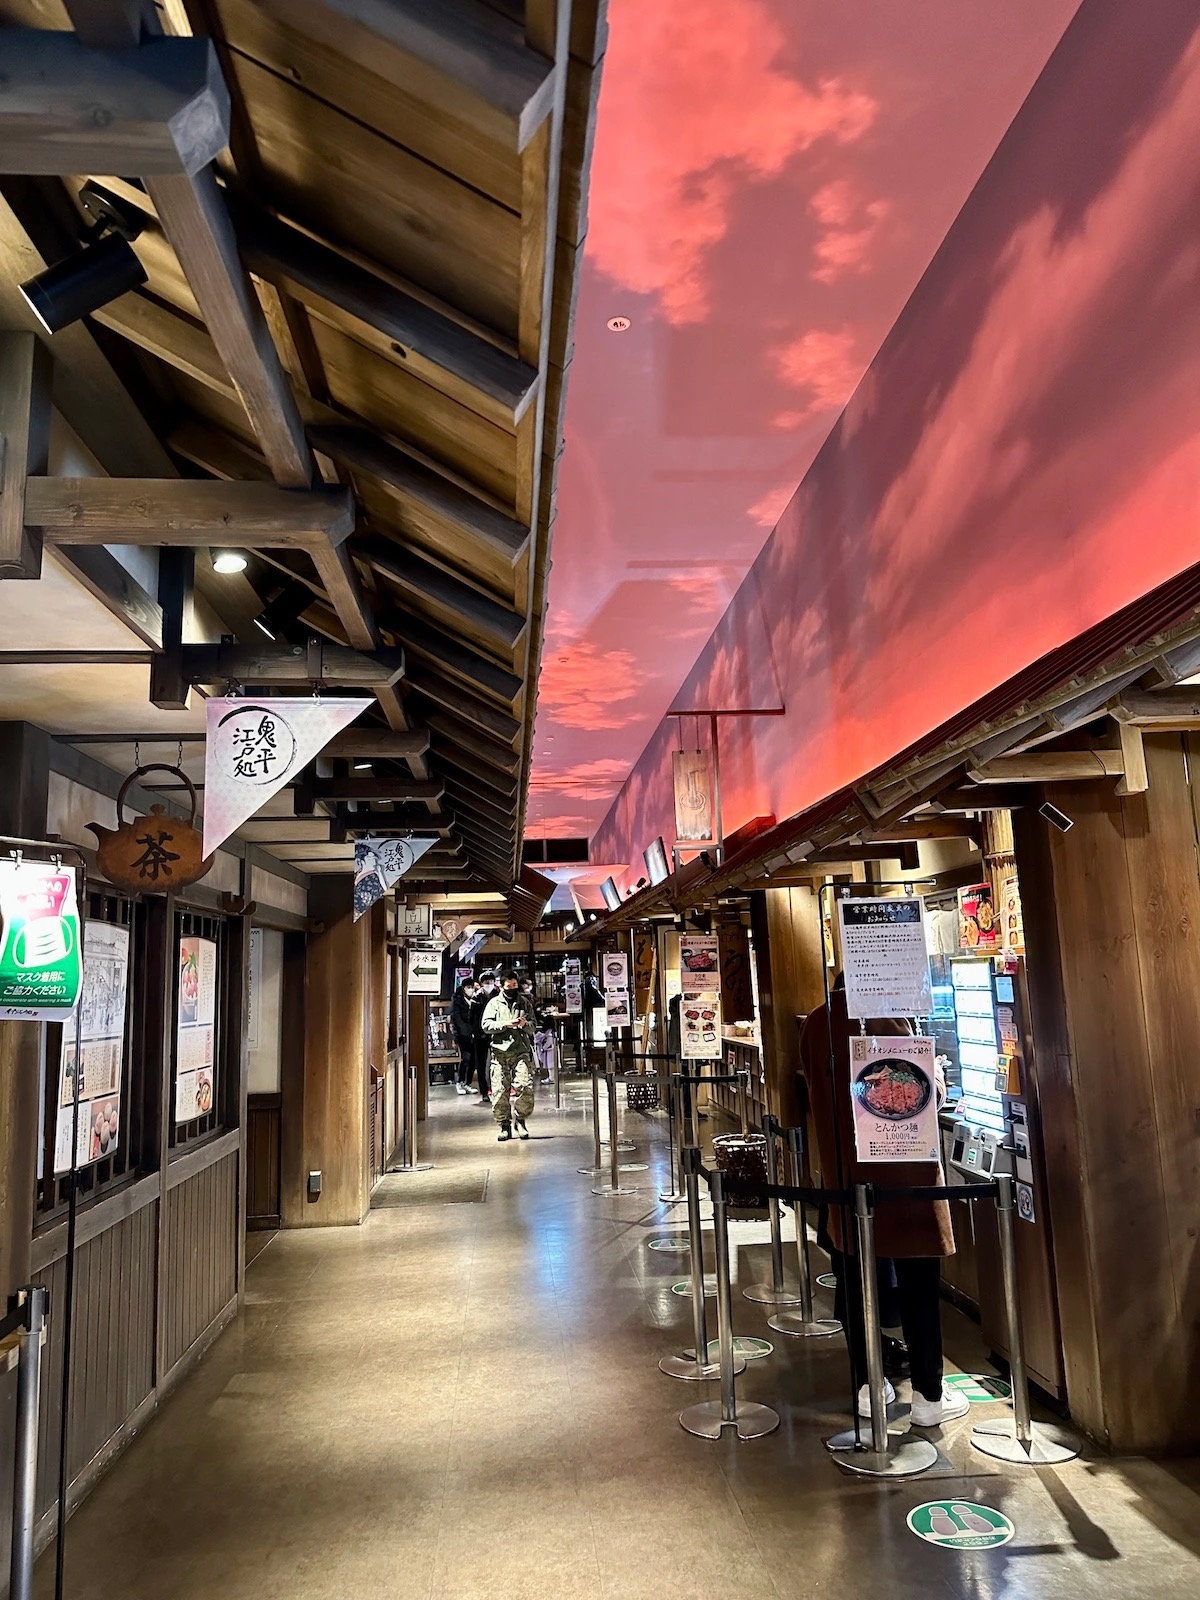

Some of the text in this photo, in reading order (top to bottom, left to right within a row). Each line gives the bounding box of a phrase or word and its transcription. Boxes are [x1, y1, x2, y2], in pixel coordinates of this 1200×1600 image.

[232, 727, 258, 778] 江戸処
[254, 715, 278, 774] 鬼平
[129, 831, 180, 880] 茶
[384, 848, 396, 872] 江戸処
[394, 842, 404, 870] 鬼平
[404, 924, 423, 934] お水
[16, 971, 66, 983] マスク着用に
[3, 985, 67, 995] ご協力ください
[875, 1122, 919, 1133] とんかつ麺
